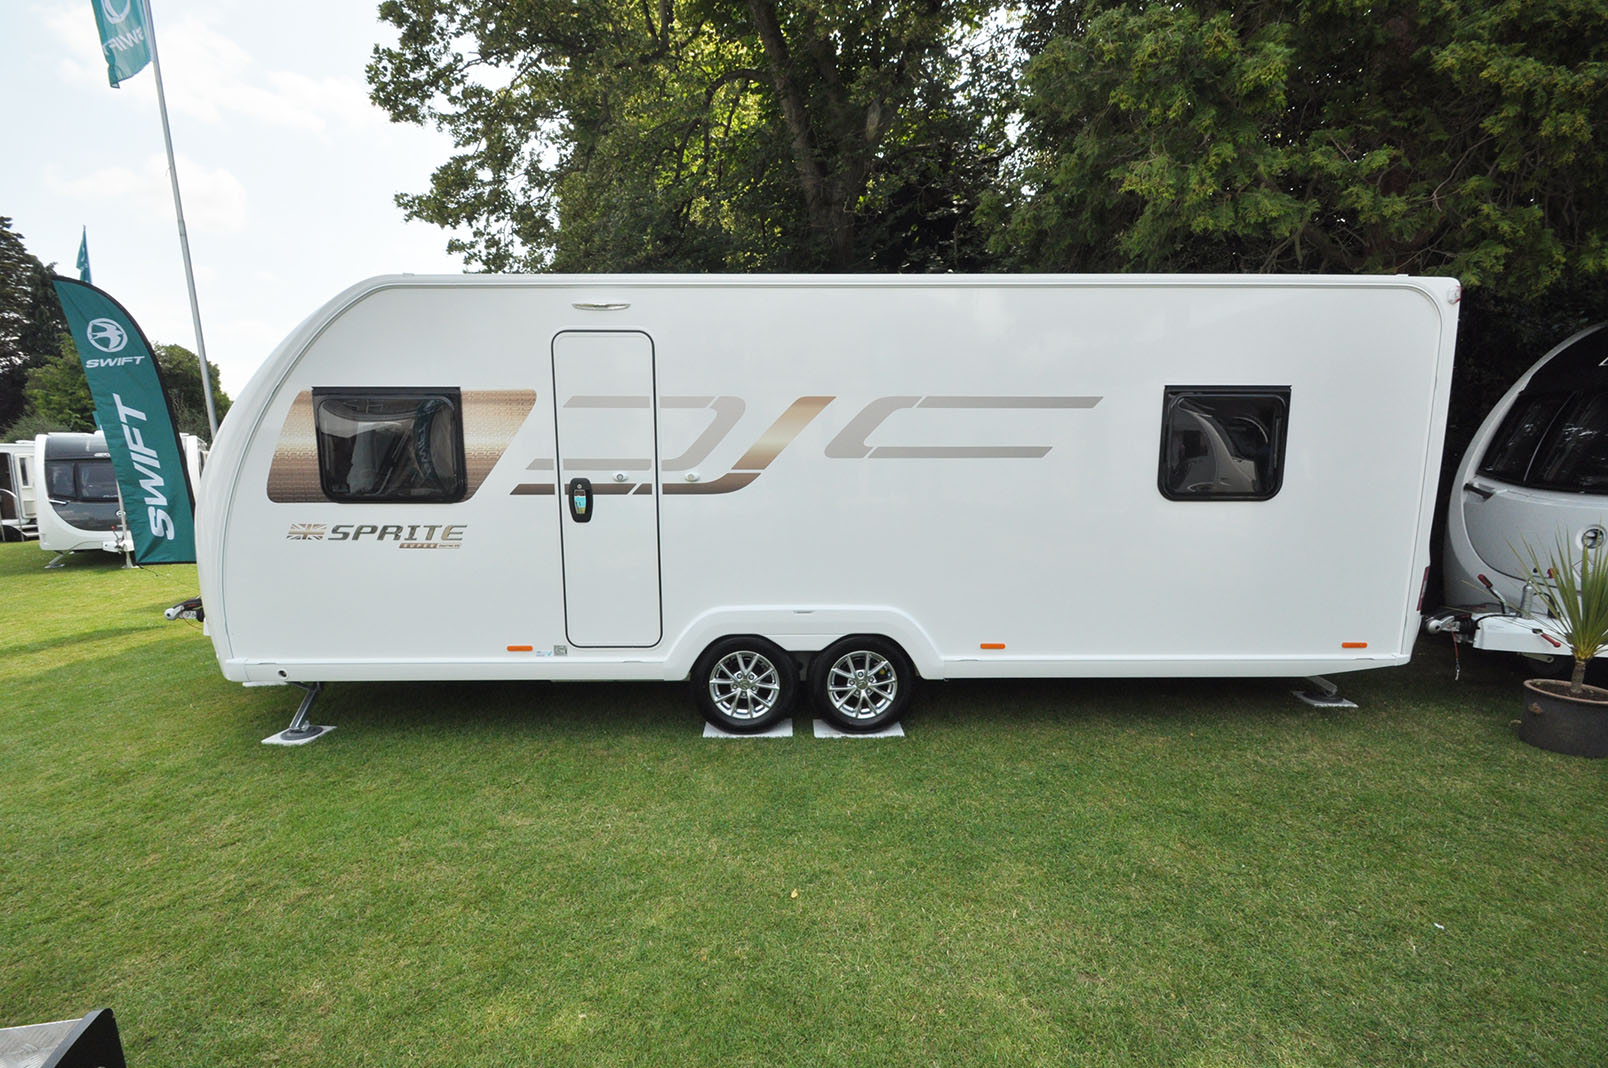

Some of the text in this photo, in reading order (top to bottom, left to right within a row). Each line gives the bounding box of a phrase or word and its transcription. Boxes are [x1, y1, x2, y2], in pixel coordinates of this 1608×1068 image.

[85, 355, 145, 369] SWIFT
[112, 393, 175, 540] SWIFT
[327, 524, 468, 541] SPRITE
